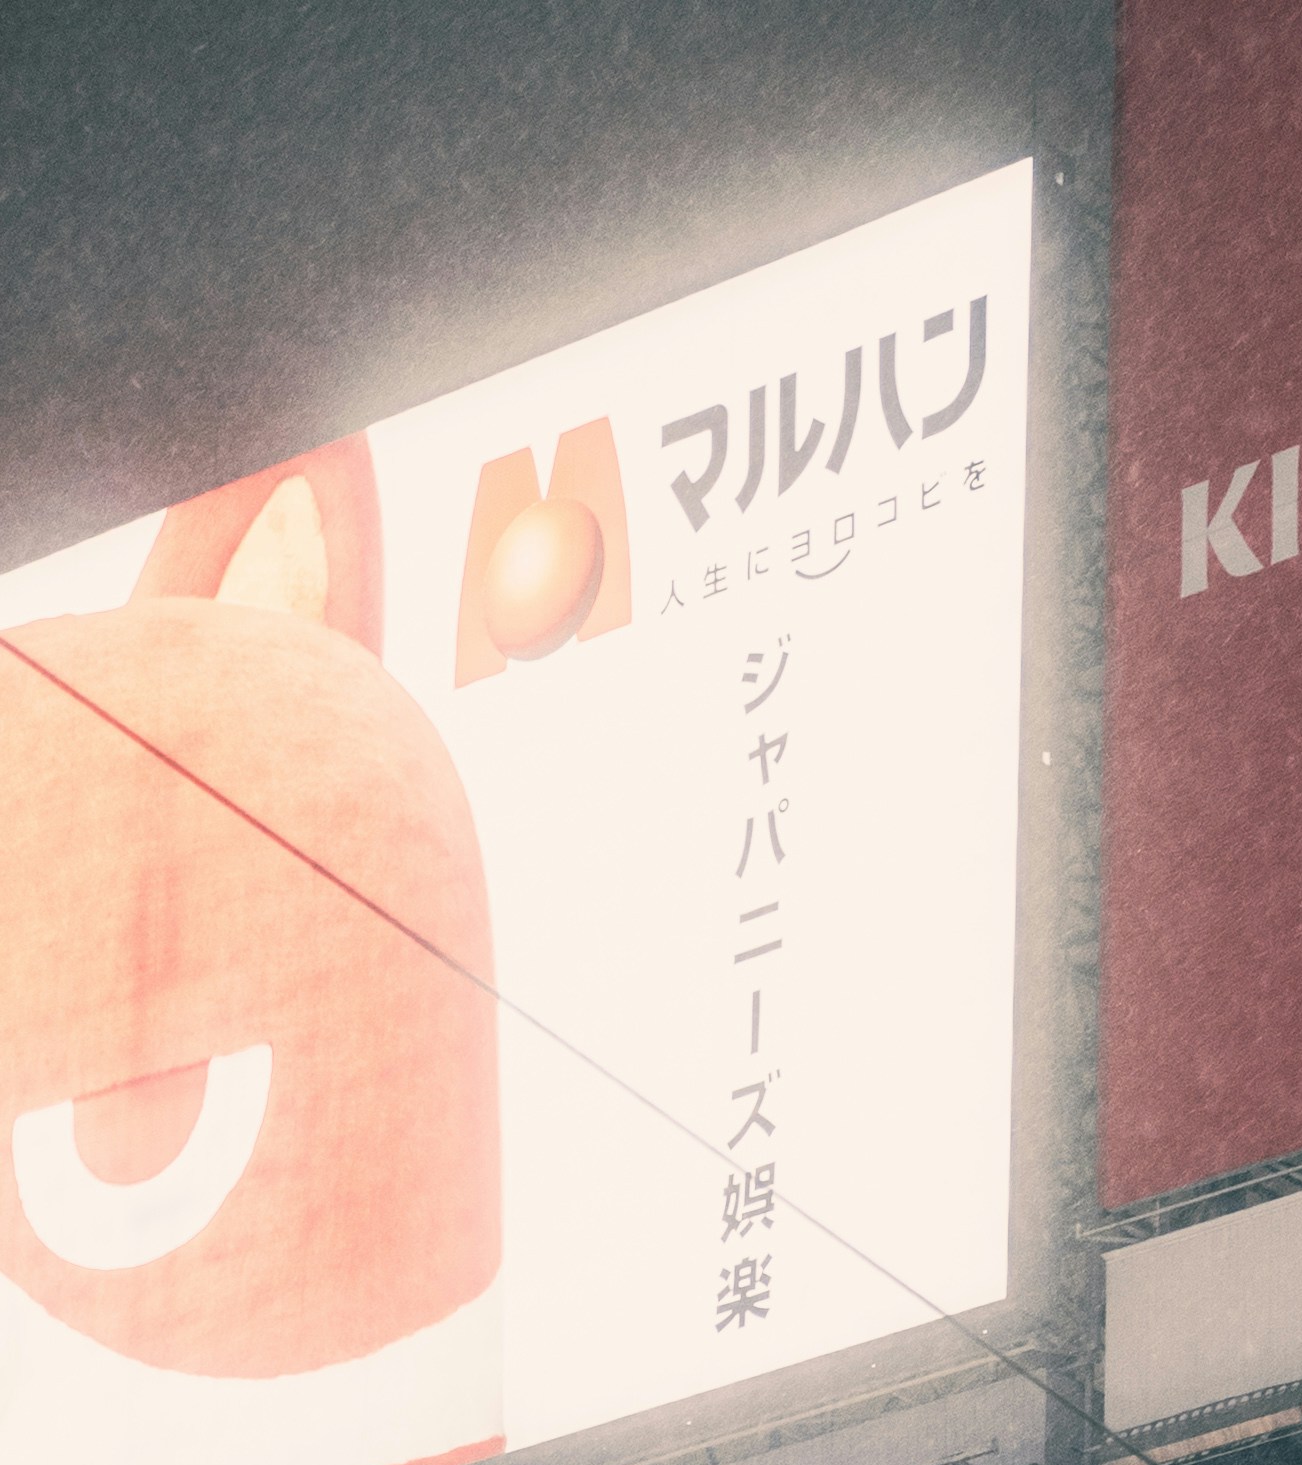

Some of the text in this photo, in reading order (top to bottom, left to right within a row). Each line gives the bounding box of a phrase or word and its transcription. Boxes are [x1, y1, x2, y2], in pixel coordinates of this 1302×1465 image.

[660, 294, 988, 533] マルハン
[660, 458, 988, 616] 人生にヨロコビを
[714, 634, 794, 1335] ジャパニーズ娯楽
